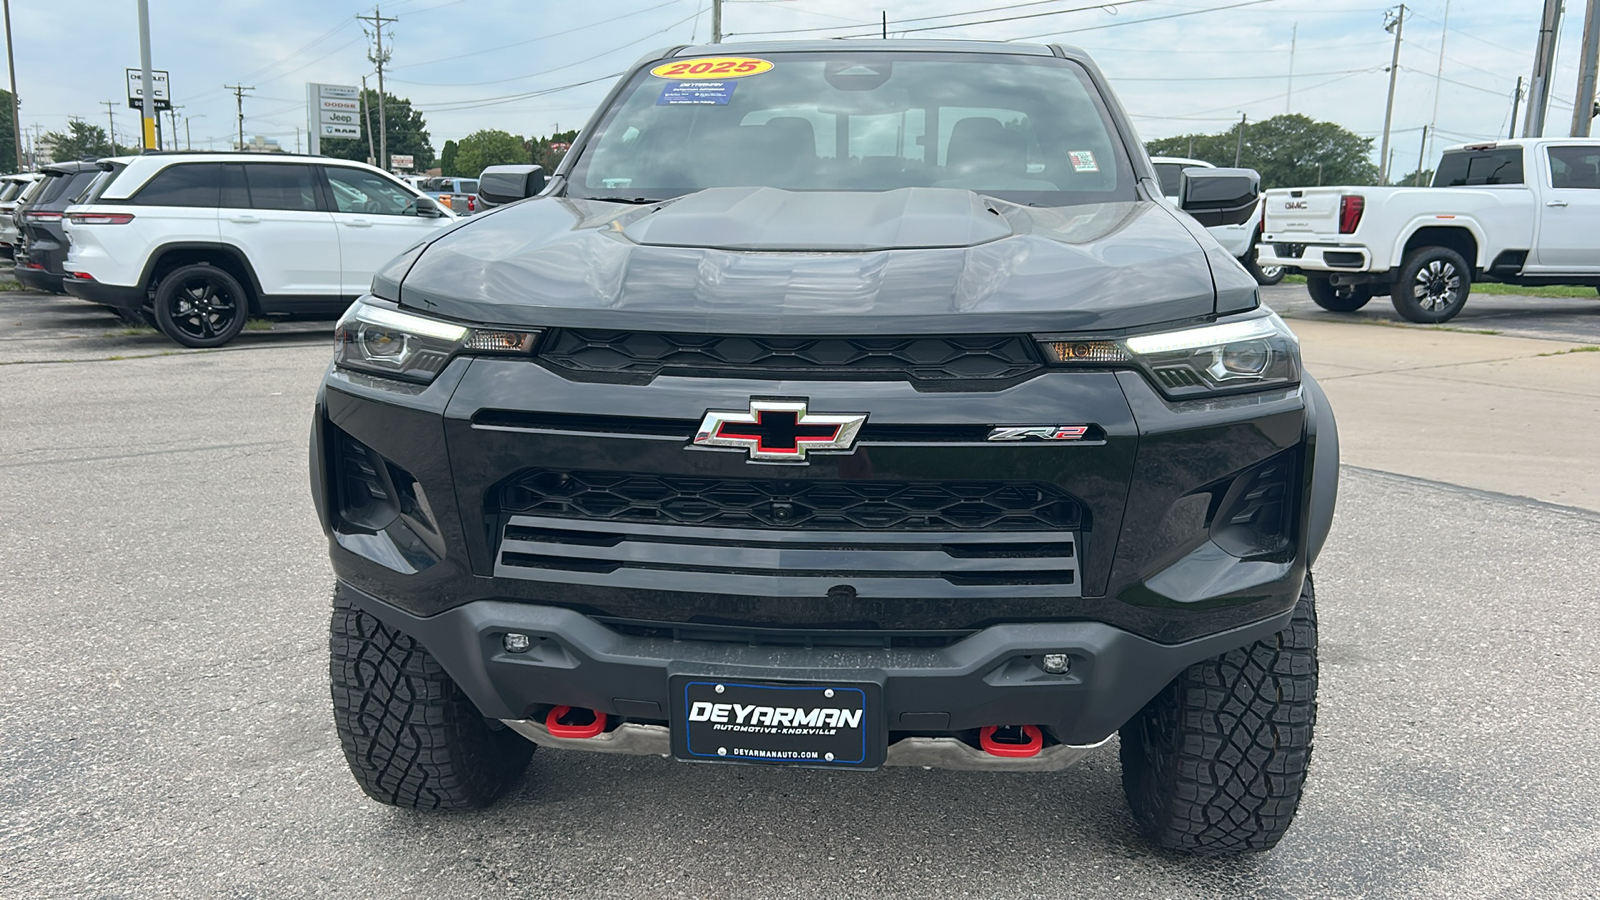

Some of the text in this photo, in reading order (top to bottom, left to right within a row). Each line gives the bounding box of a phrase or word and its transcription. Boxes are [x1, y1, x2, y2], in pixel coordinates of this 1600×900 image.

[662, 61, 762, 76] 2025
[329, 112, 352, 123] Jeep
[1284, 201, 1308, 210] GMC
[987, 426, 1089, 441] ZR2
[688, 701, 863, 729] DEYARMAN
[713, 724, 837, 736] AUTOMOTIVE-KNOXVILLE
[733, 747, 819, 759] DEYARMANAUTO.COM
